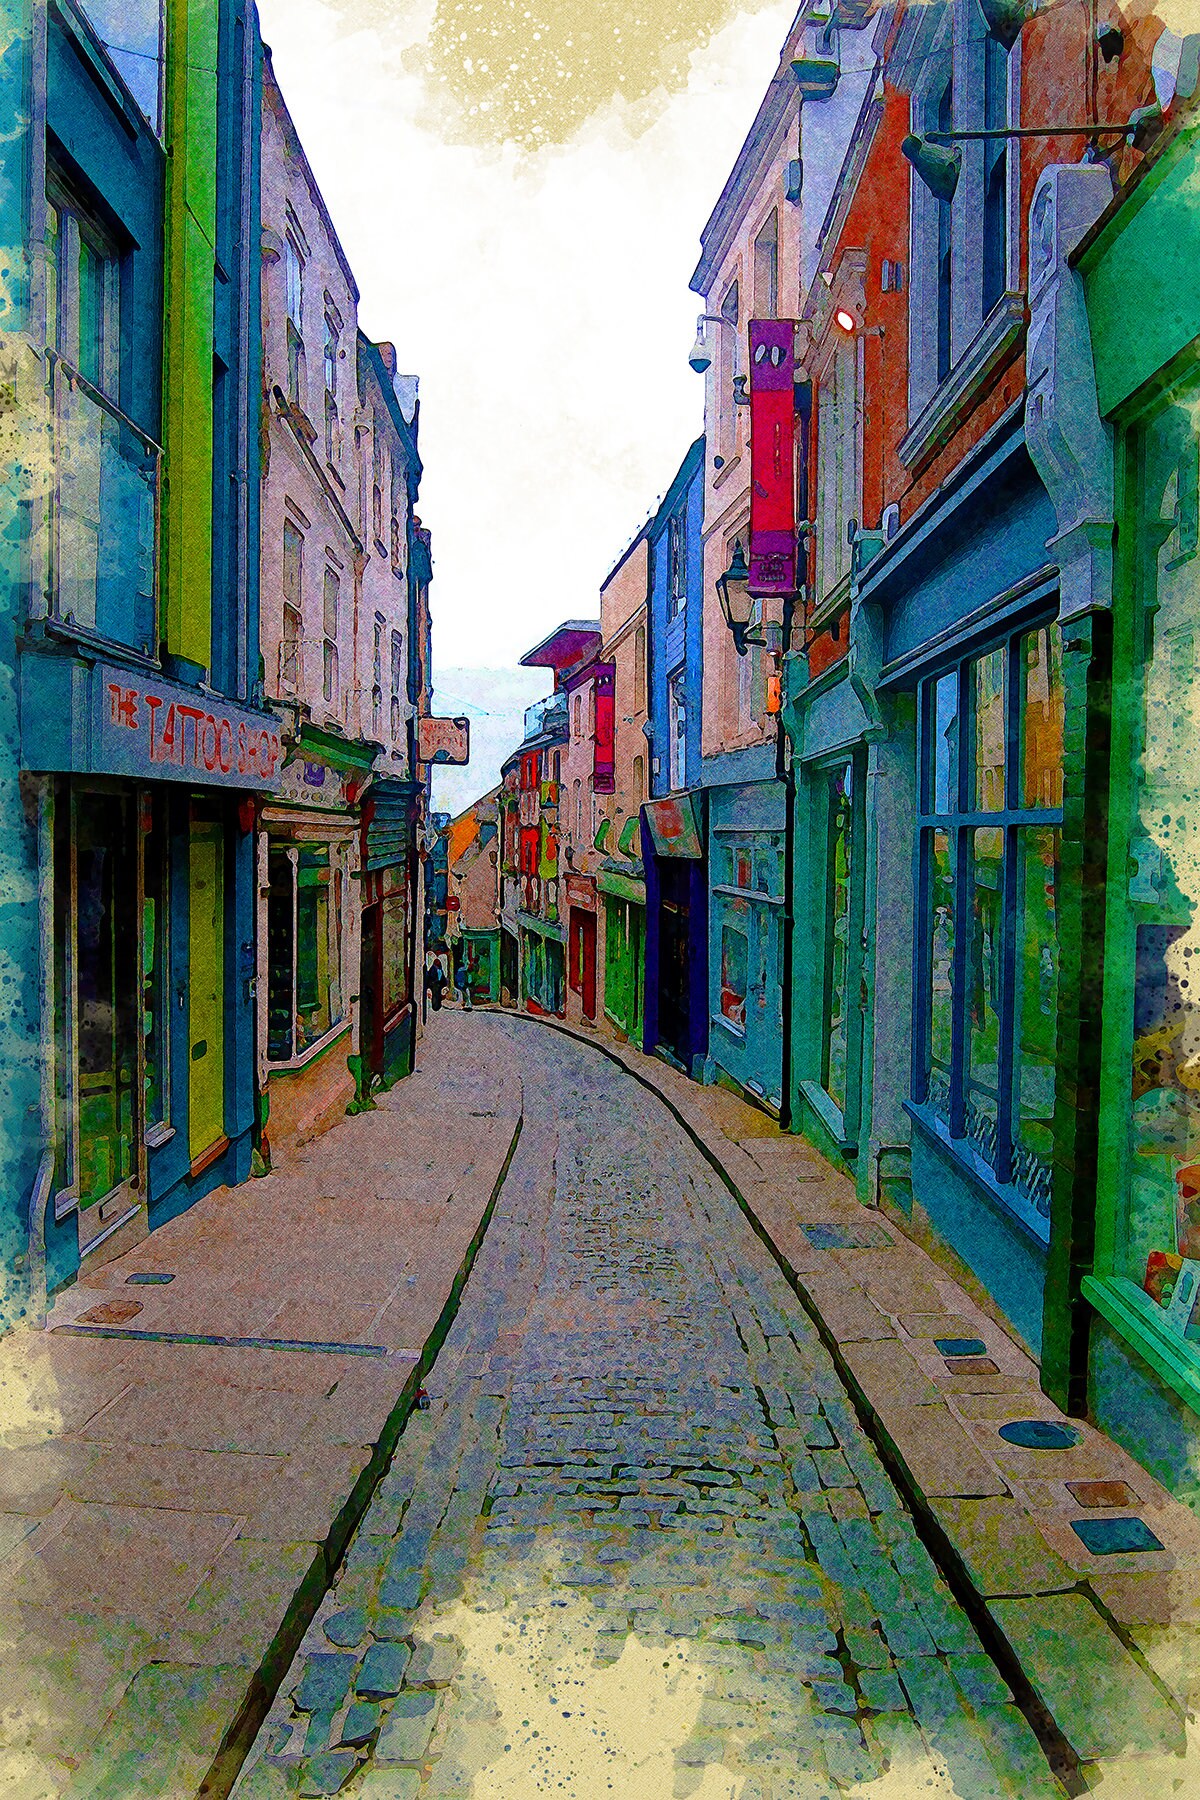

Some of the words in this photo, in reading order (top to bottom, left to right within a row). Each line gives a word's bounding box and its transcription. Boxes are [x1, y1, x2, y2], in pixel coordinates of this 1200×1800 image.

[108, 683, 139, 729] THE
[144, 695, 234, 774] TATTOO
[237, 721, 280, 779] SHOP
